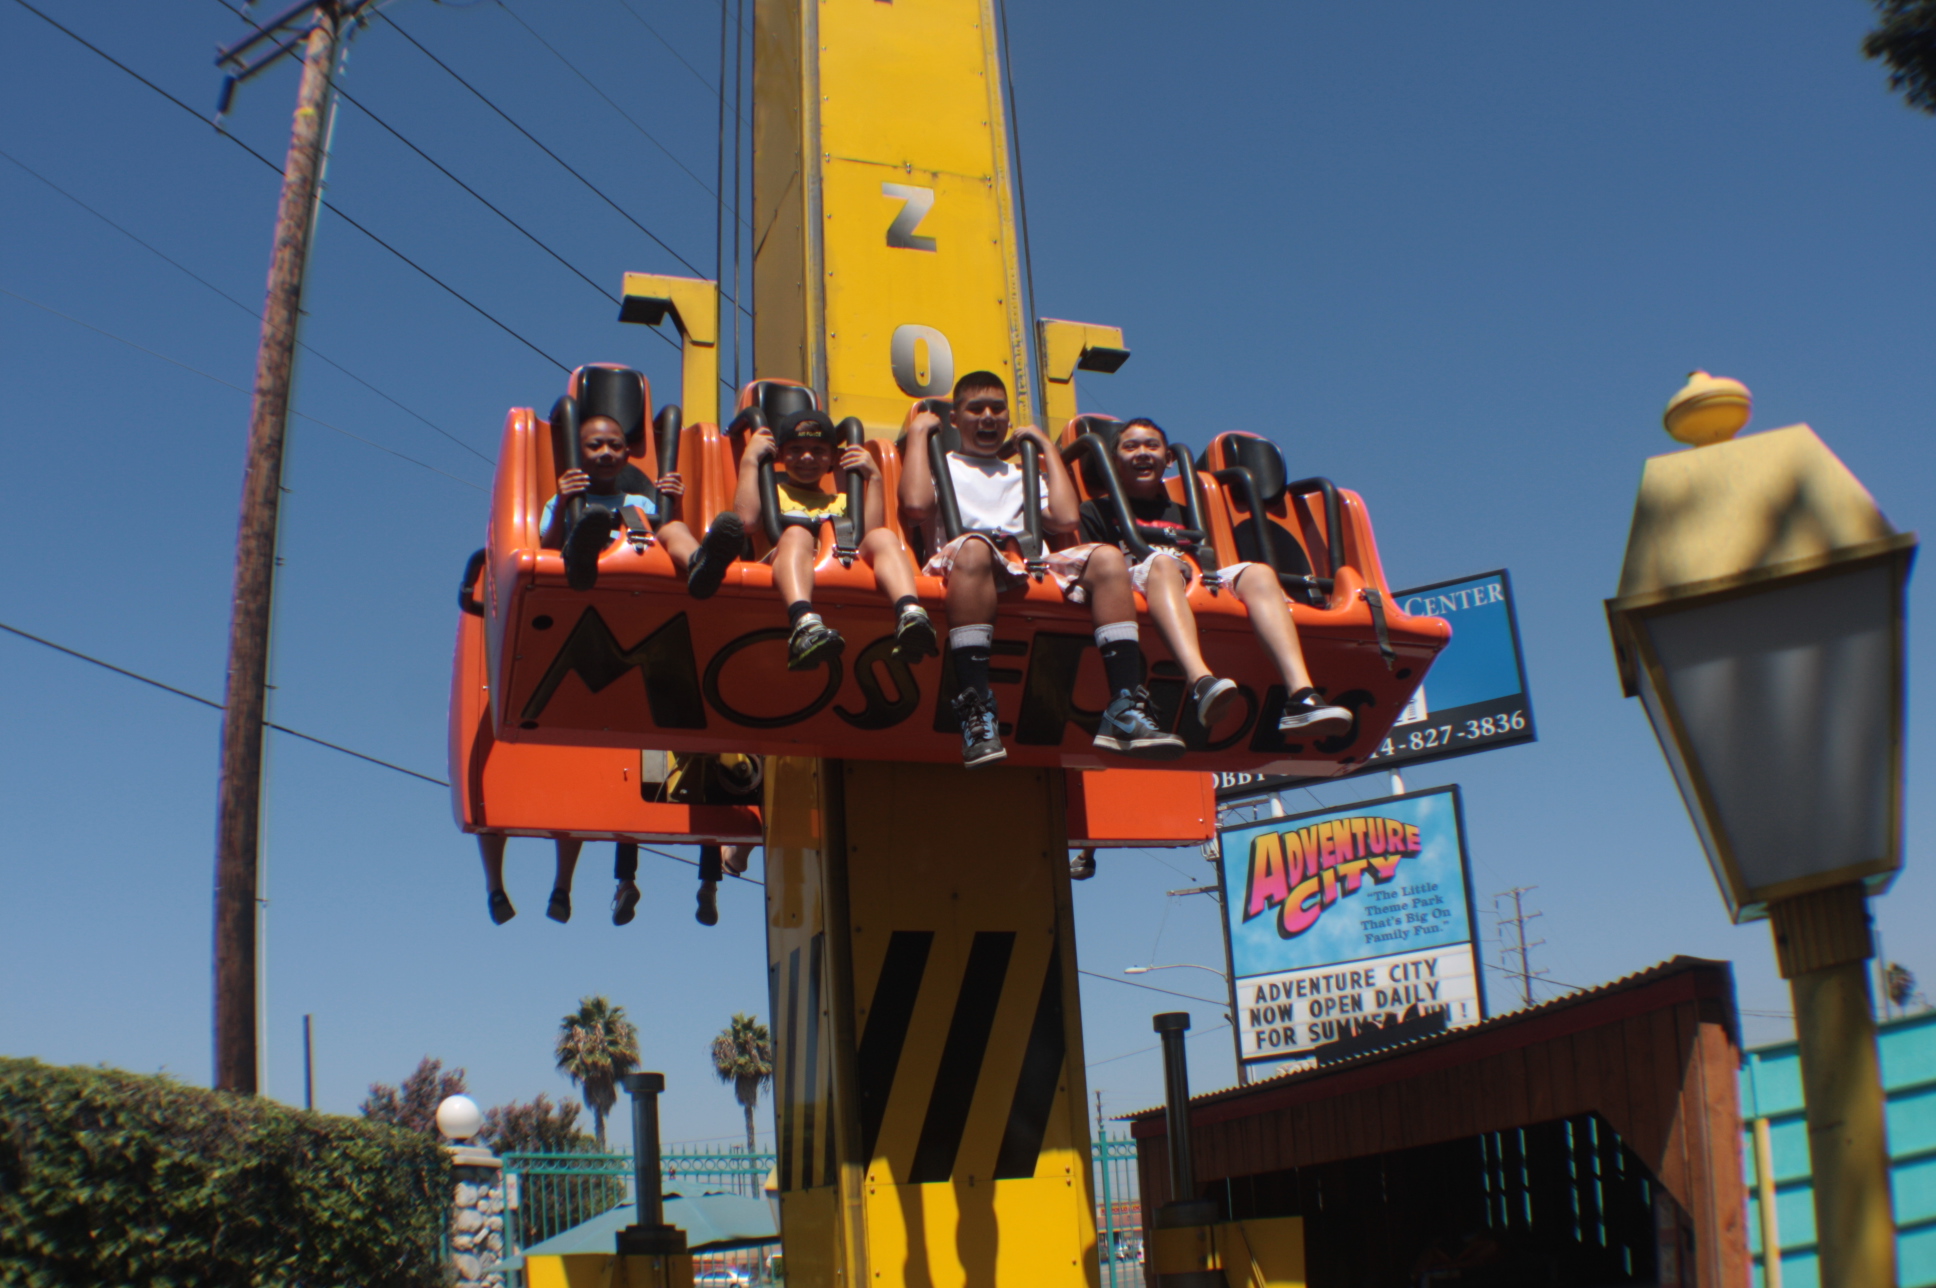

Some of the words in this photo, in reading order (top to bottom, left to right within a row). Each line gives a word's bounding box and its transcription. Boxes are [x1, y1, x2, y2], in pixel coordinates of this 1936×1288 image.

[1404, 583, 1505, 617] CENTER
[1243, 816, 1422, 924] ADVENTURE
[1277, 855, 1402, 940] CITY
[1401, 882, 1439, 897] Little
[1360, 916, 1402, 931] That's
[1405, 912, 1429, 924] Big
[1431, 908, 1452, 919] On
[1364, 902, 1408, 917] Theme
[1411, 894, 1444, 909] Park
[1364, 928, 1410, 944] Family
[1255, 968, 1376, 1005] ADVENTURE
[1389, 958, 1438, 983] CITY
[1250, 1003, 1294, 1028] NOW
[1309, 993, 1364, 1019] OPEN
[1375, 980, 1440, 1009] DAILY
[1255, 1026, 1298, 1050] FOR
